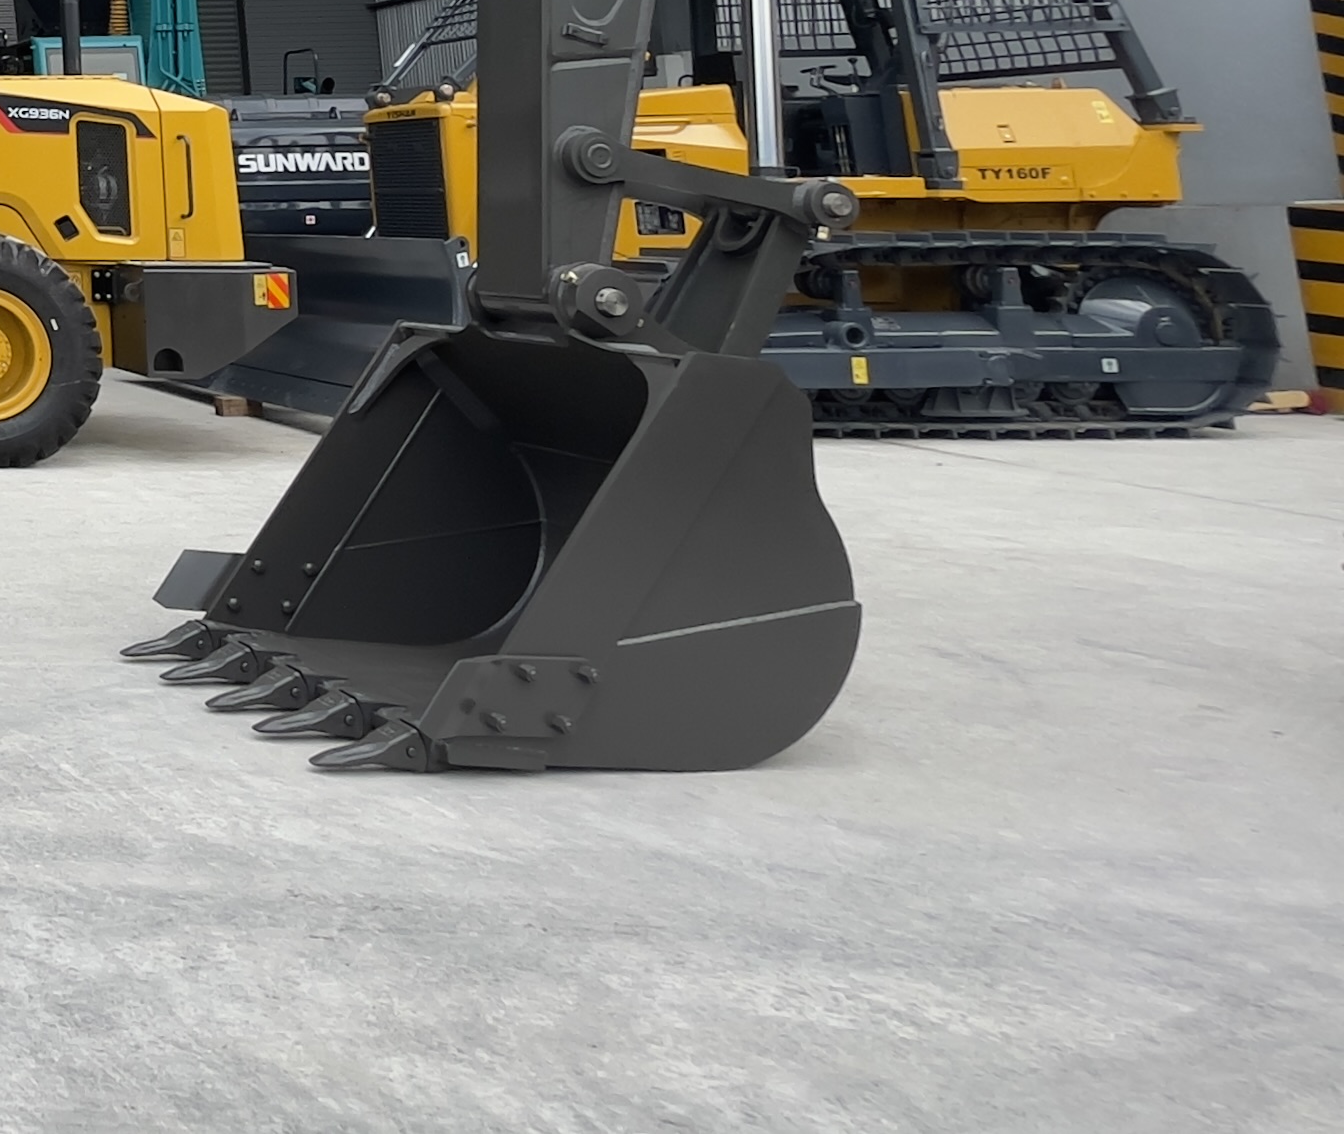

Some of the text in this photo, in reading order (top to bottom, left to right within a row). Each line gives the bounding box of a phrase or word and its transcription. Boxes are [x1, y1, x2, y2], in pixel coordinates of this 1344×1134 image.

[7, 106, 70, 120] XG936N
[238, 152, 370, 173] SUNWARD
[977, 167, 1051, 180] TY160F
